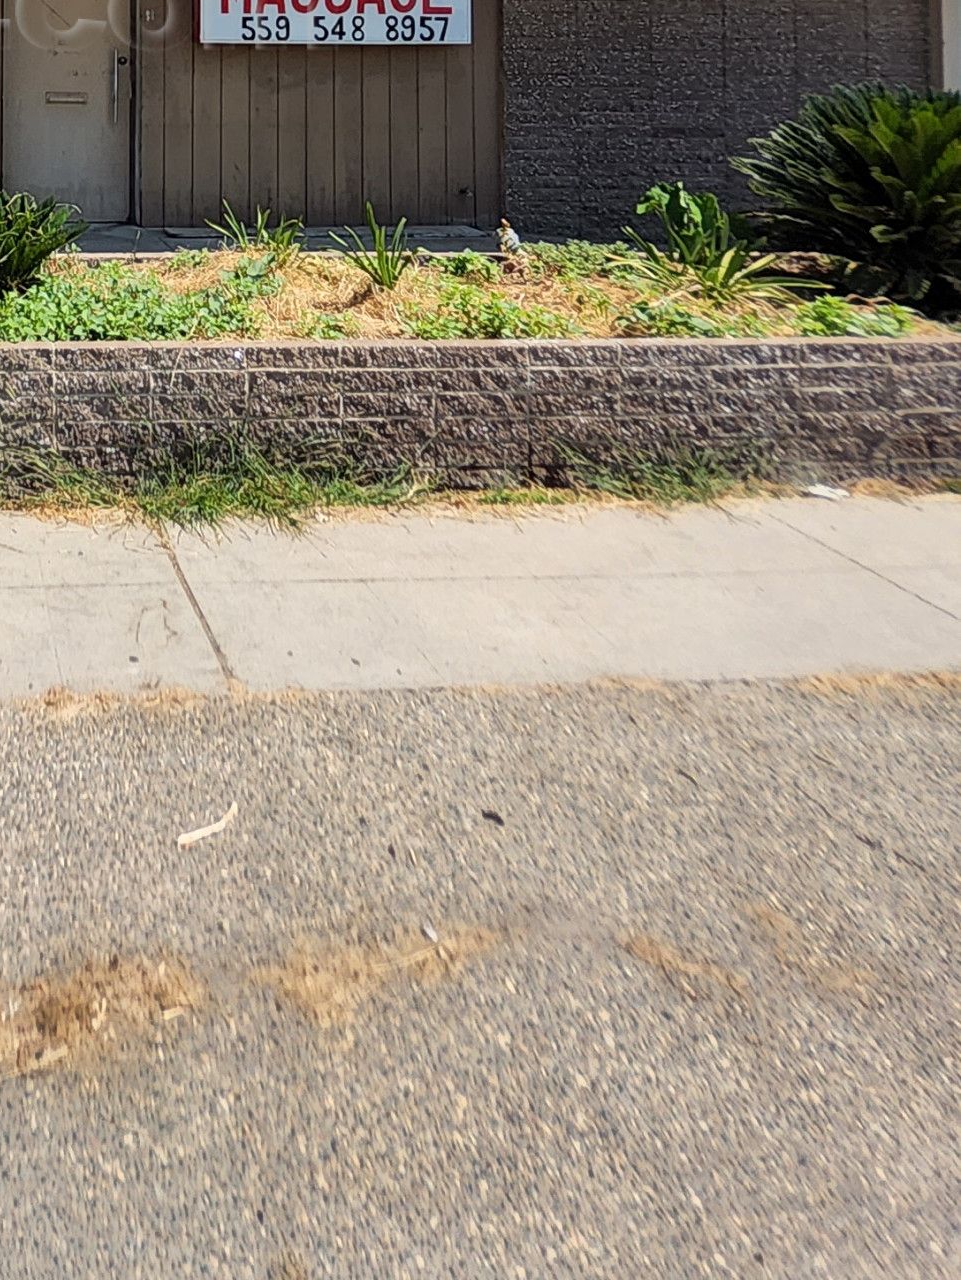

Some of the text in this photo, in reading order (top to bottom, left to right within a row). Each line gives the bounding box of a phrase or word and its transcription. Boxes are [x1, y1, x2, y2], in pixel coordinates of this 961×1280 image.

[241, 15, 449, 41] 559 548 8957
